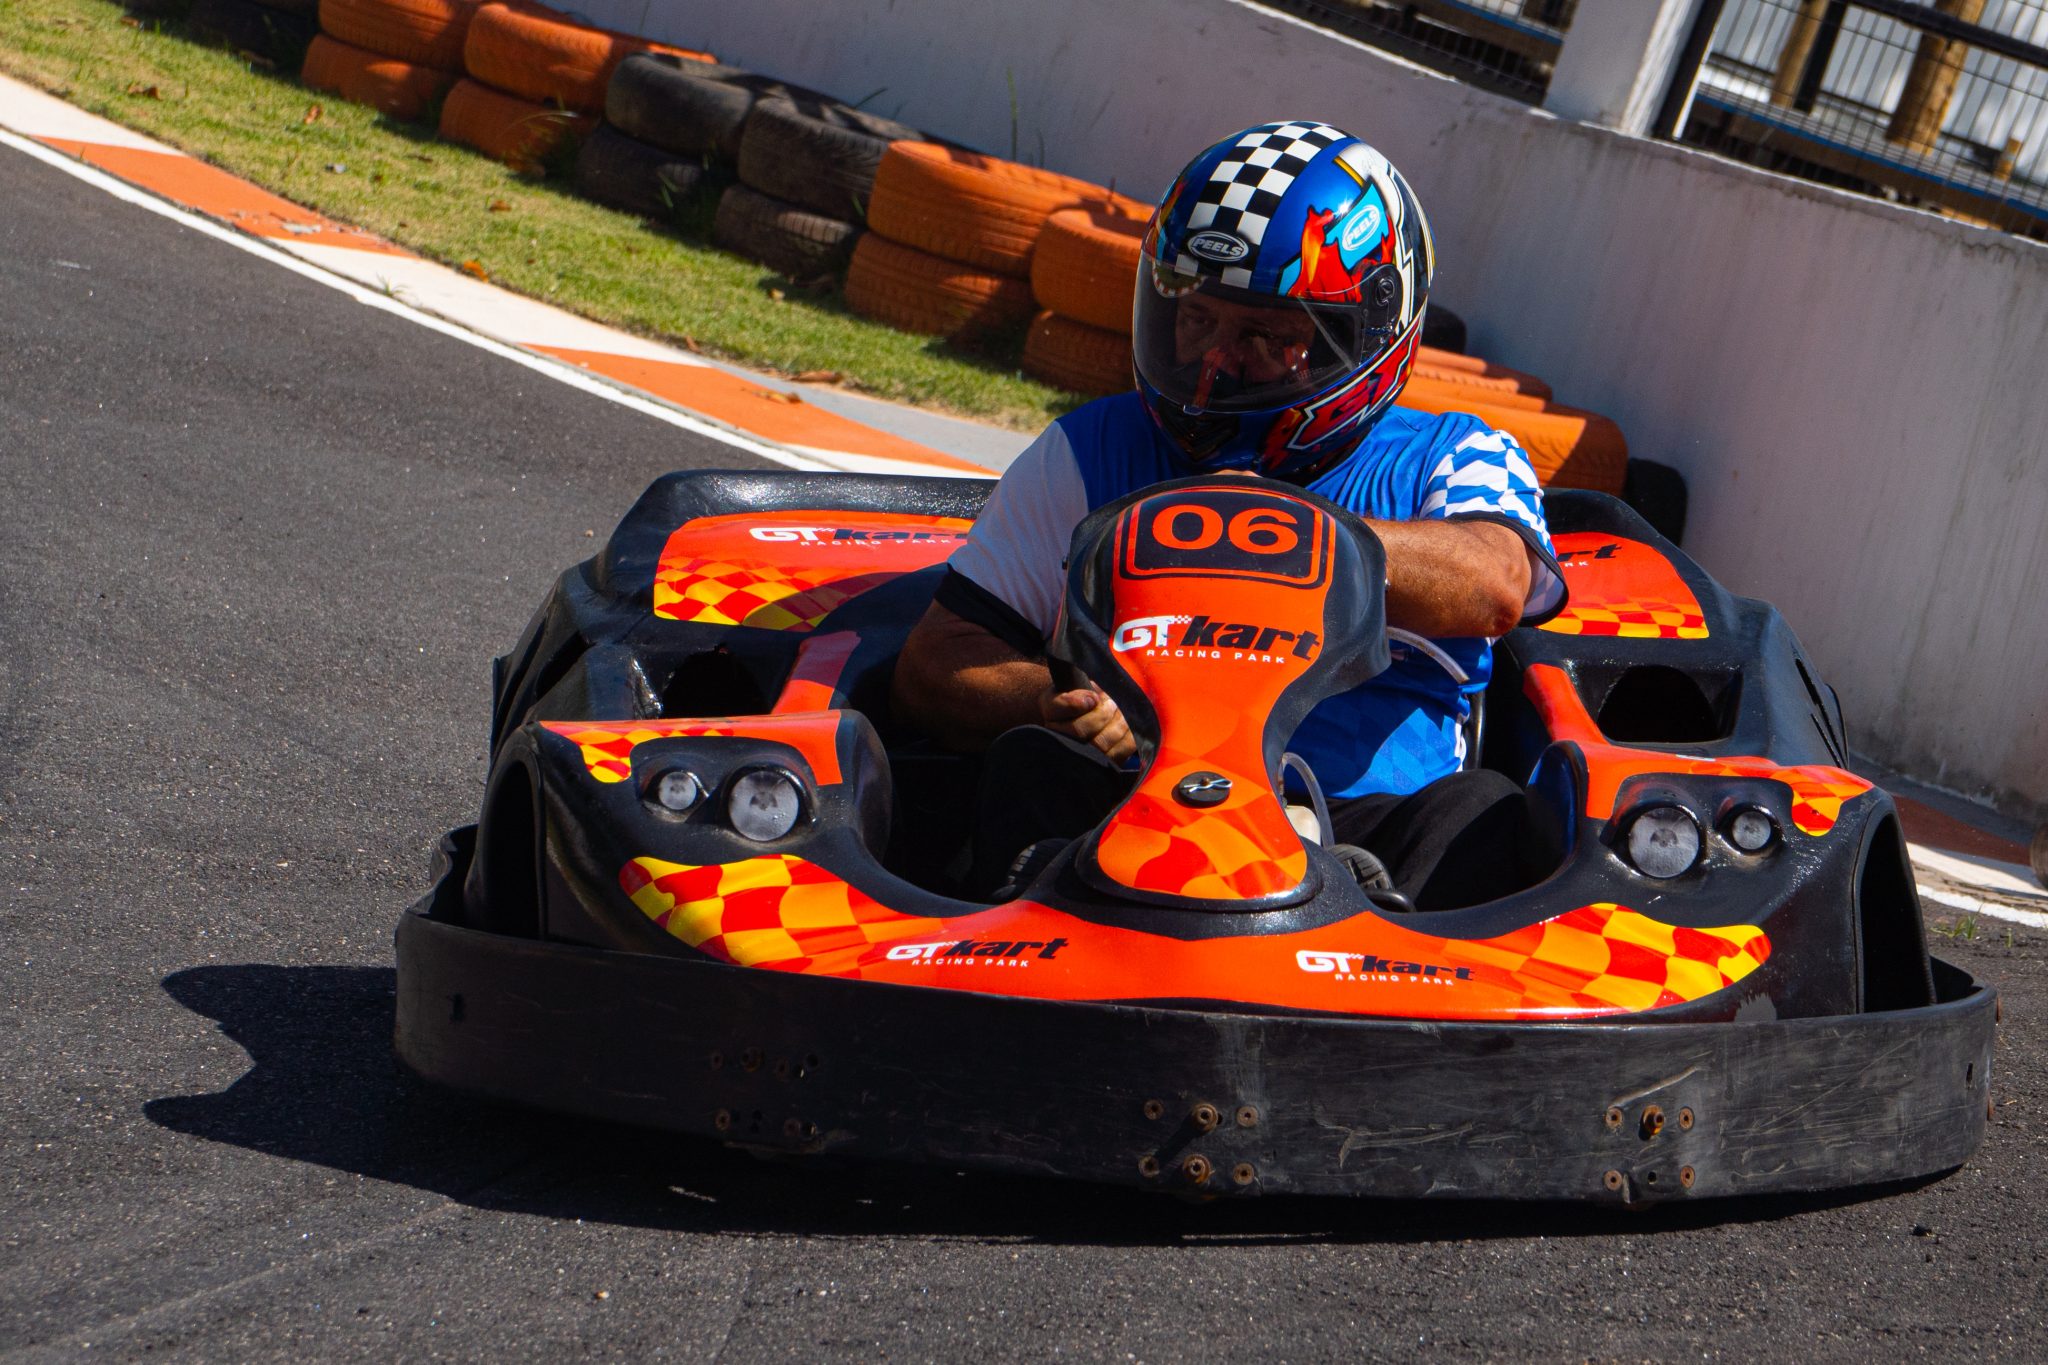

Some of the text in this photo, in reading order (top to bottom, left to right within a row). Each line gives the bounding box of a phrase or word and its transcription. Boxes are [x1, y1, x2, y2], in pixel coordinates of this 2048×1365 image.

[1347, 210, 1377, 246] PEELS
[1192, 238, 1243, 256] PEELS
[1152, 504, 1298, 555] 06
[1147, 649, 1285, 664] RACING PARK
[912, 957, 1029, 967] RACING PARK
[1335, 973, 1454, 986] RACING PARK
